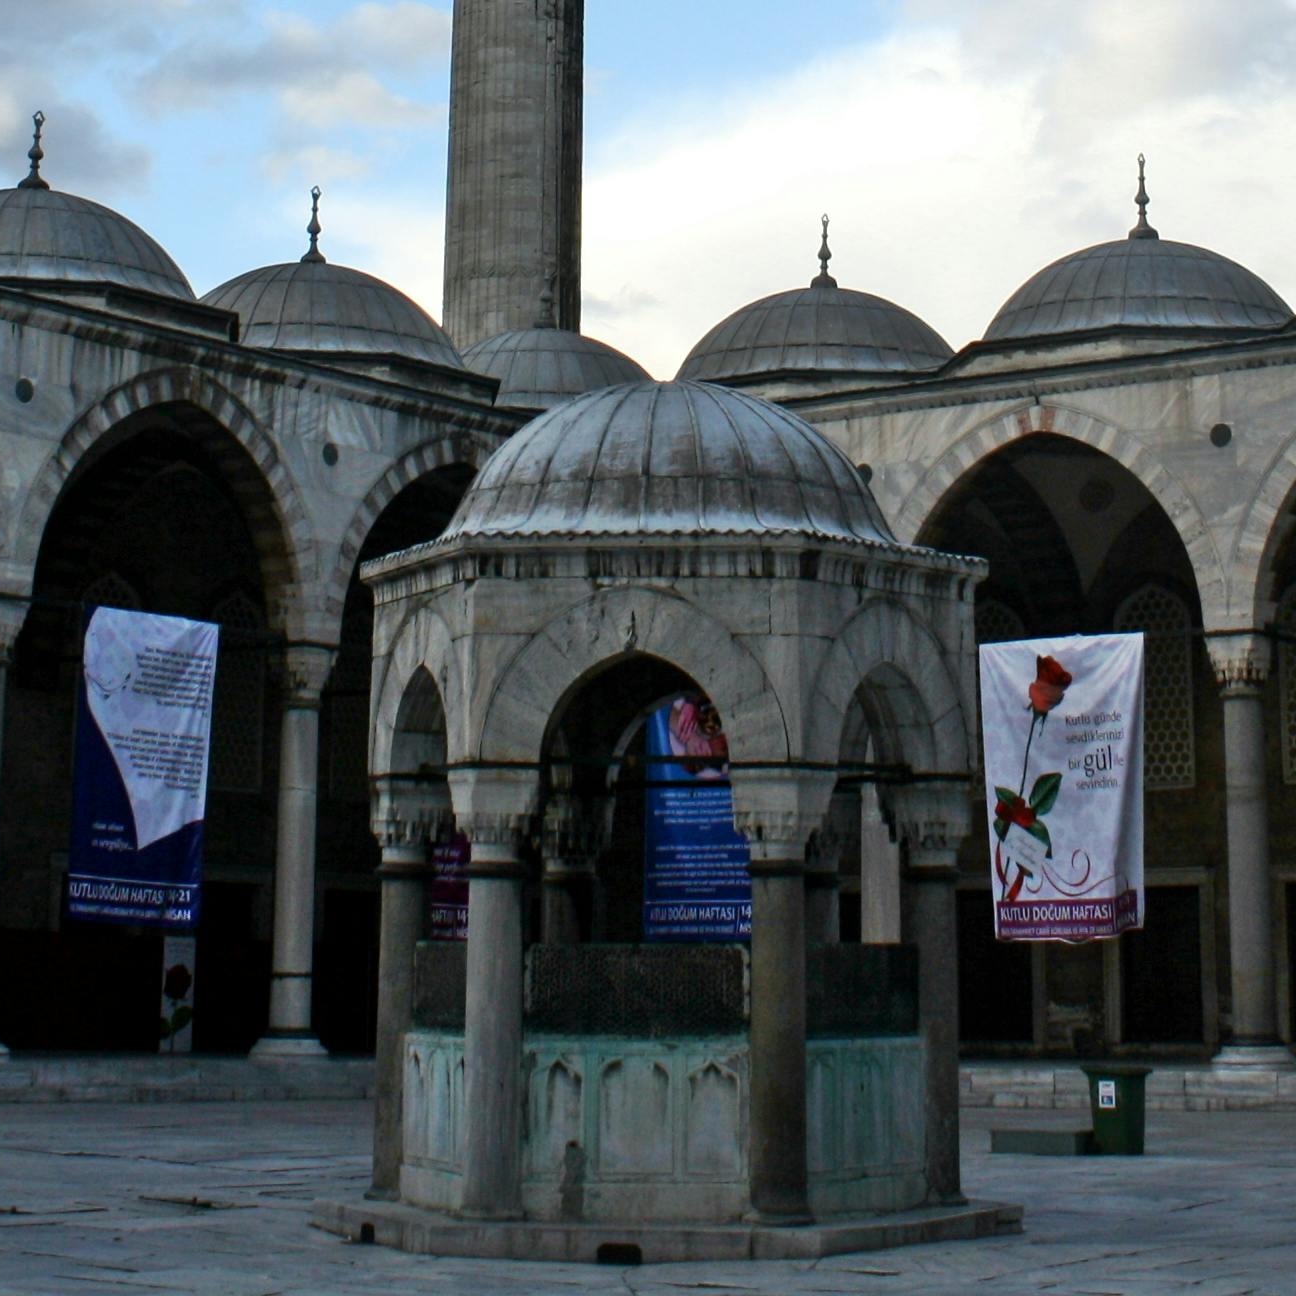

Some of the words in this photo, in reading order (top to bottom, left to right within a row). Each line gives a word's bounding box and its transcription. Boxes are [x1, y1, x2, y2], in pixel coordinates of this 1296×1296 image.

[1065, 713, 1091, 727] Kutlu
[1094, 710, 1122, 725] günde
[1084, 744, 1112, 777] gül
[698, 906, 735, 921] HAFTASI
[1000, 905, 1030, 921] KUTLU
[1033, 903, 1071, 921] DOĞUM
[1072, 904, 1112, 920] HAFTASI
